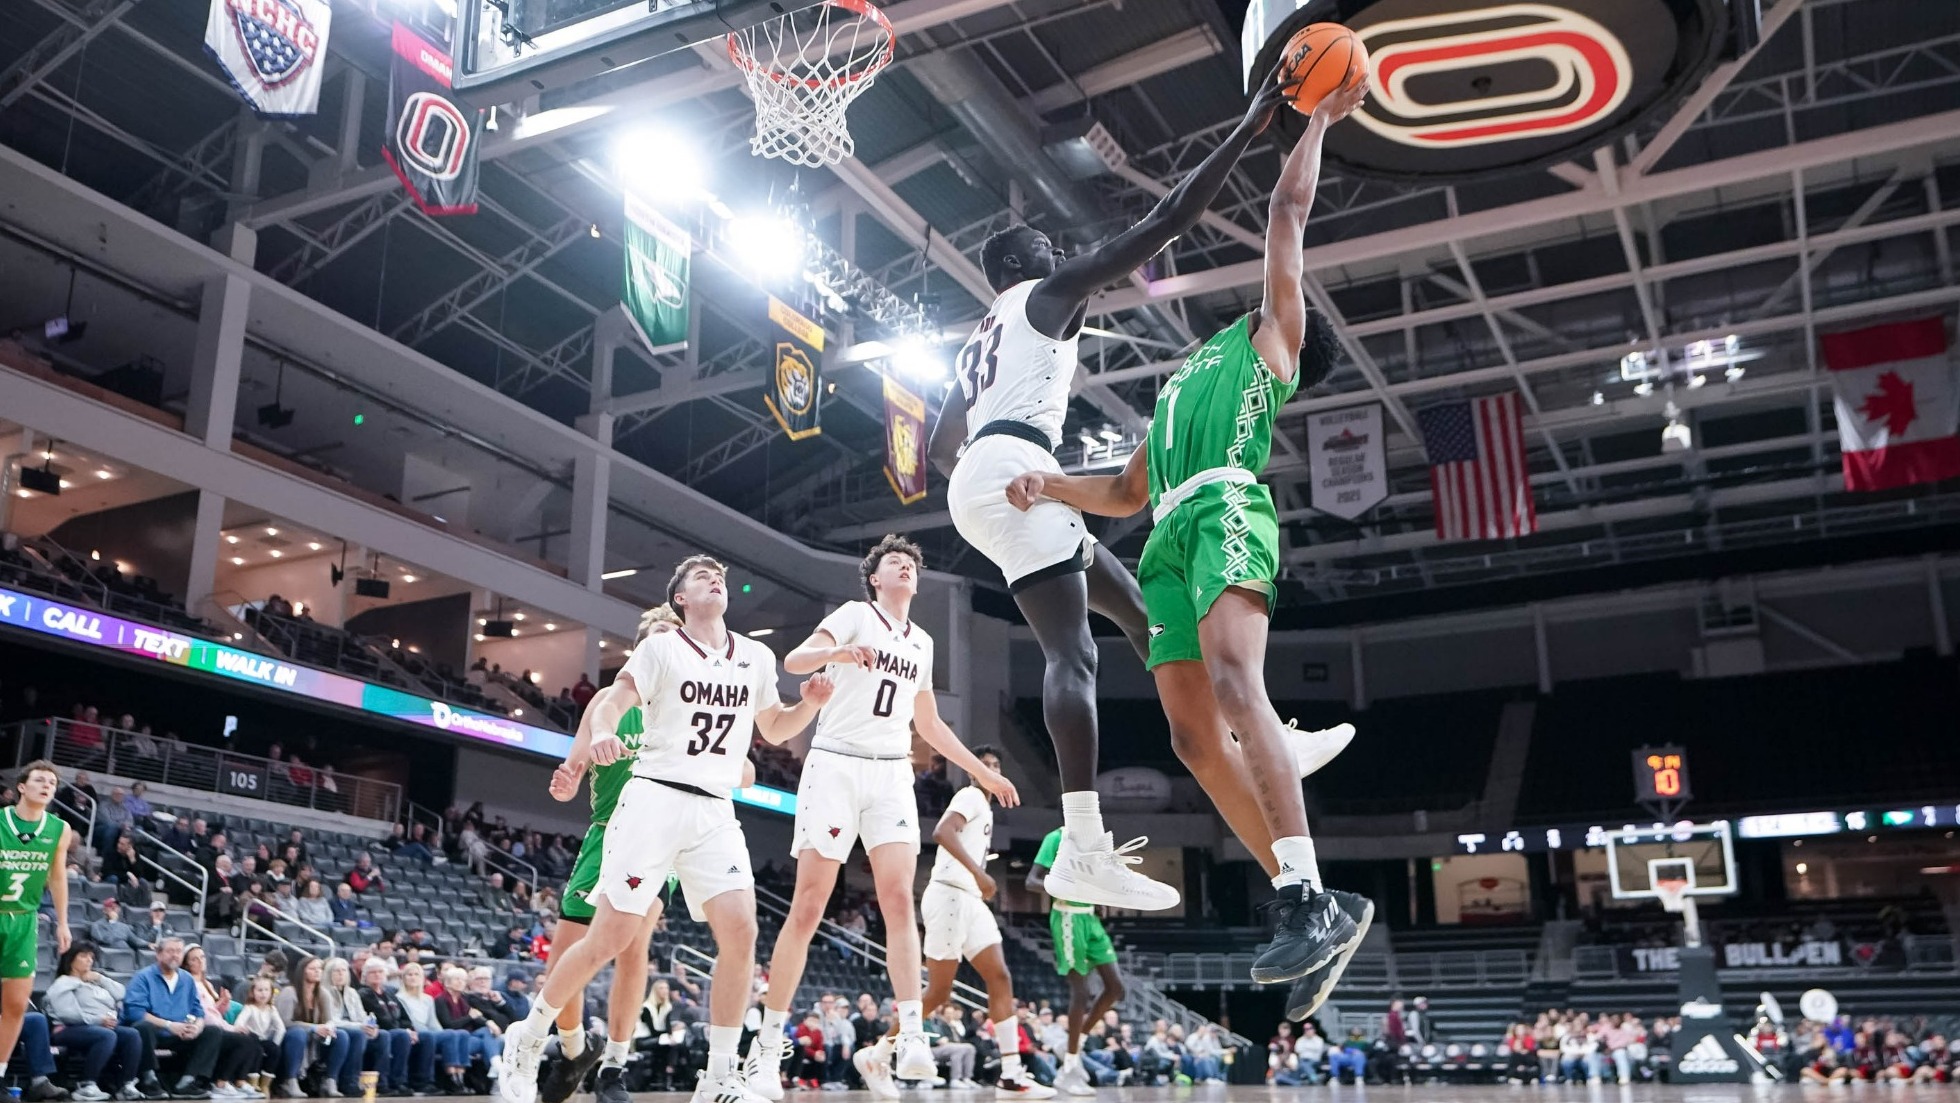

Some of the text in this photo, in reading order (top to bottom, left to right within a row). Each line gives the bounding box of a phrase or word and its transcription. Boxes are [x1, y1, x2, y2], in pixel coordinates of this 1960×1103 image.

[420, 49, 452, 81] OMAH
[961, 323, 1003, 412] 33
[1165, 386, 1182, 450] 1
[43, 606, 102, 639] CALL
[133, 628, 189, 659] TEXT
[215, 650, 275, 681] WALK
[273, 668, 297, 687] IN
[873, 648, 918, 683] MAHA
[680, 680, 749, 707] OMAHA
[873, 679, 897, 717] 0
[687, 711, 736, 756] 32
[230, 771, 257, 790] 105
[0, 849, 49, 861] NORTH
[0, 860, 49, 871] AKOTA
[0, 872, 31, 901] 3
[1631, 946, 1681, 972] THE
